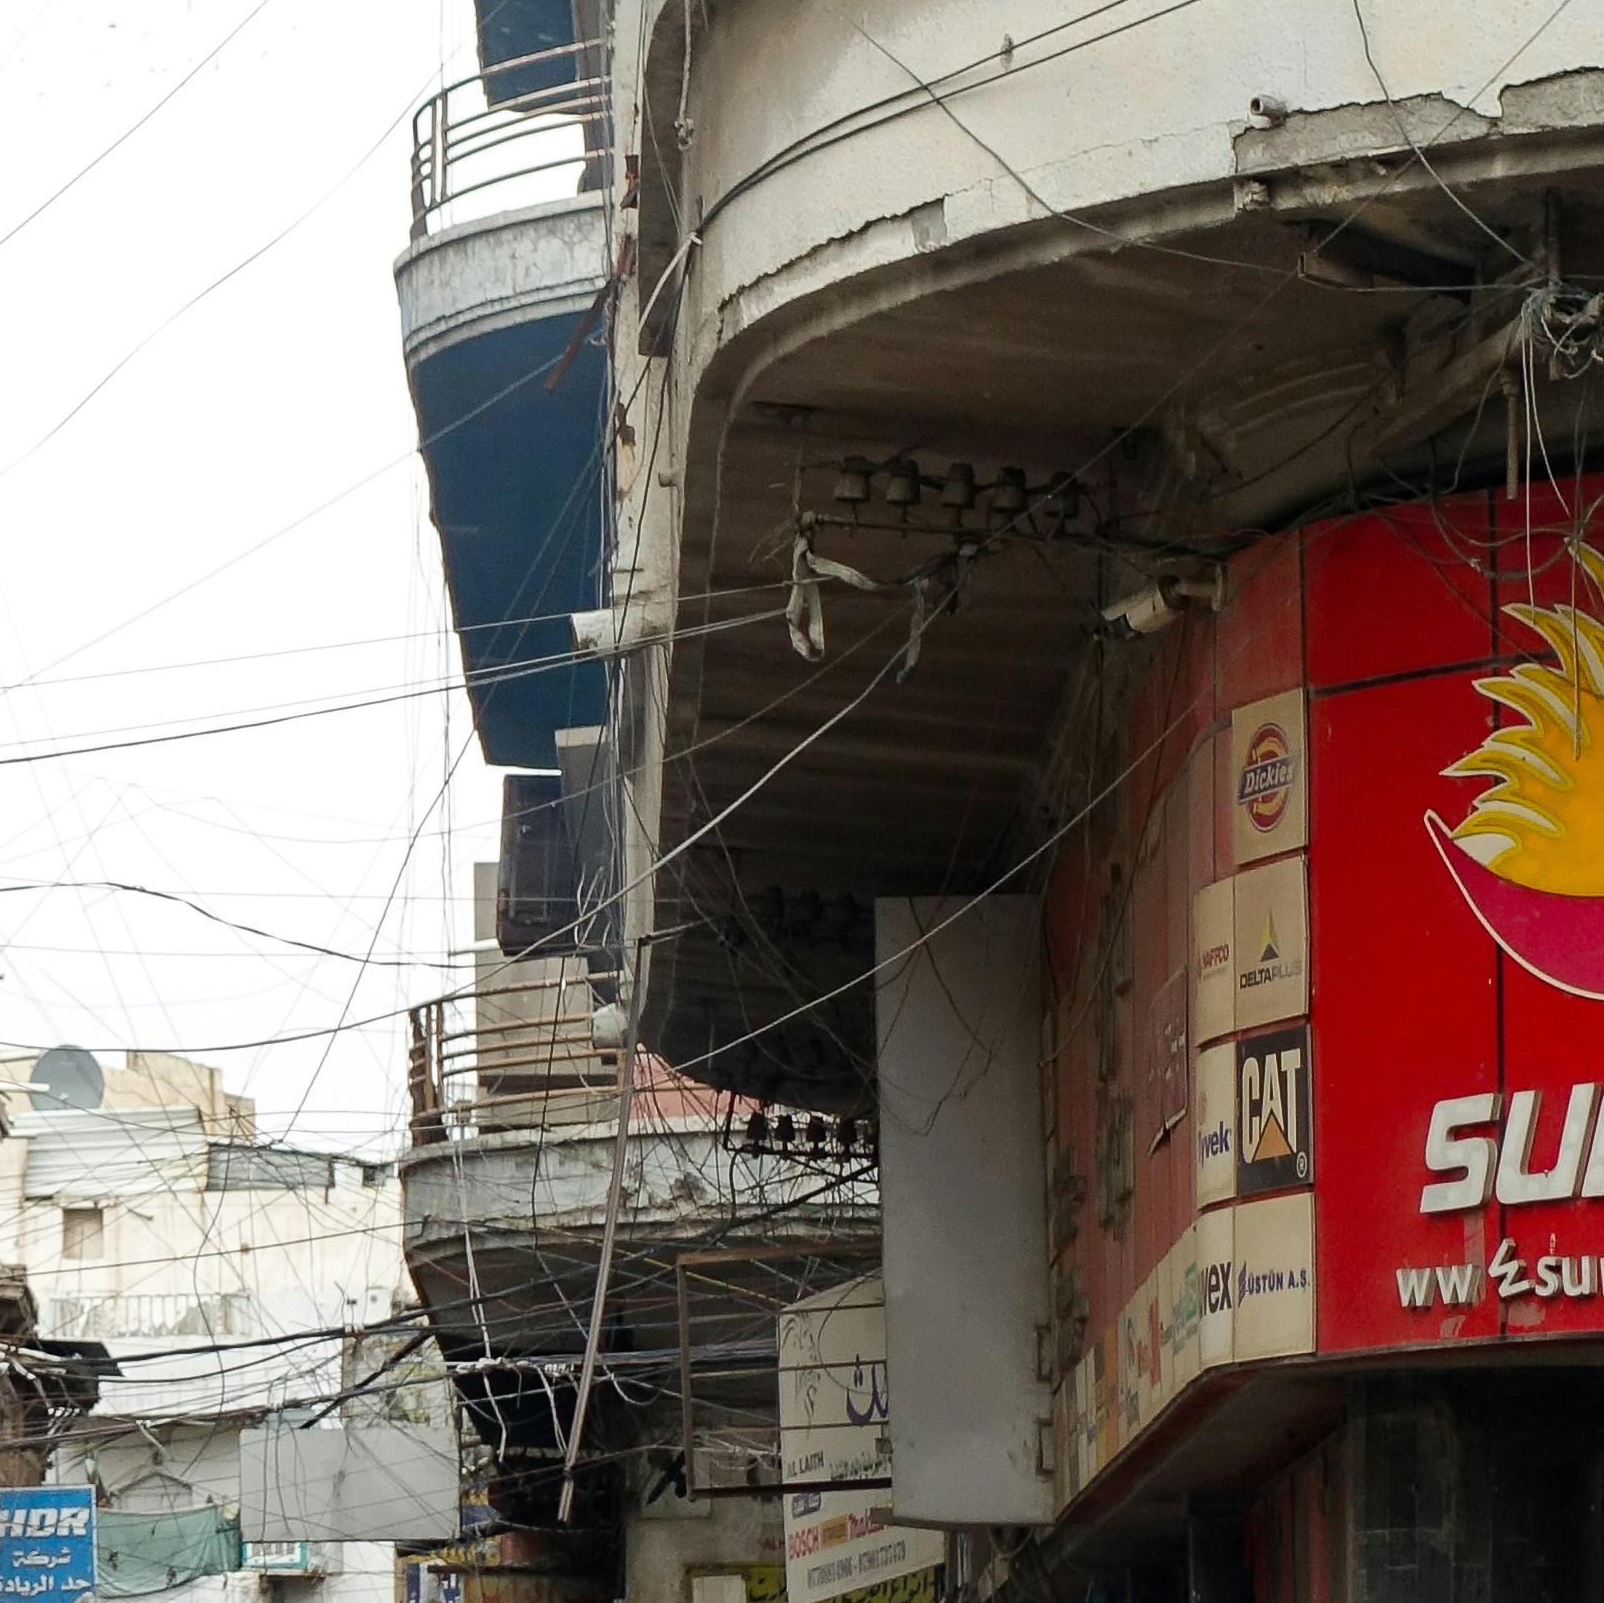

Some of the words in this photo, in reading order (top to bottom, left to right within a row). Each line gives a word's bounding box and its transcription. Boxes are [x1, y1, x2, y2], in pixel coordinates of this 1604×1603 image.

[1244, 765, 1294, 794] Dickies
[1242, 1048, 1301, 1164] CAT
[1419, 1082, 1604, 1214] SU
[12, 1545, 71, 1569] شركة
